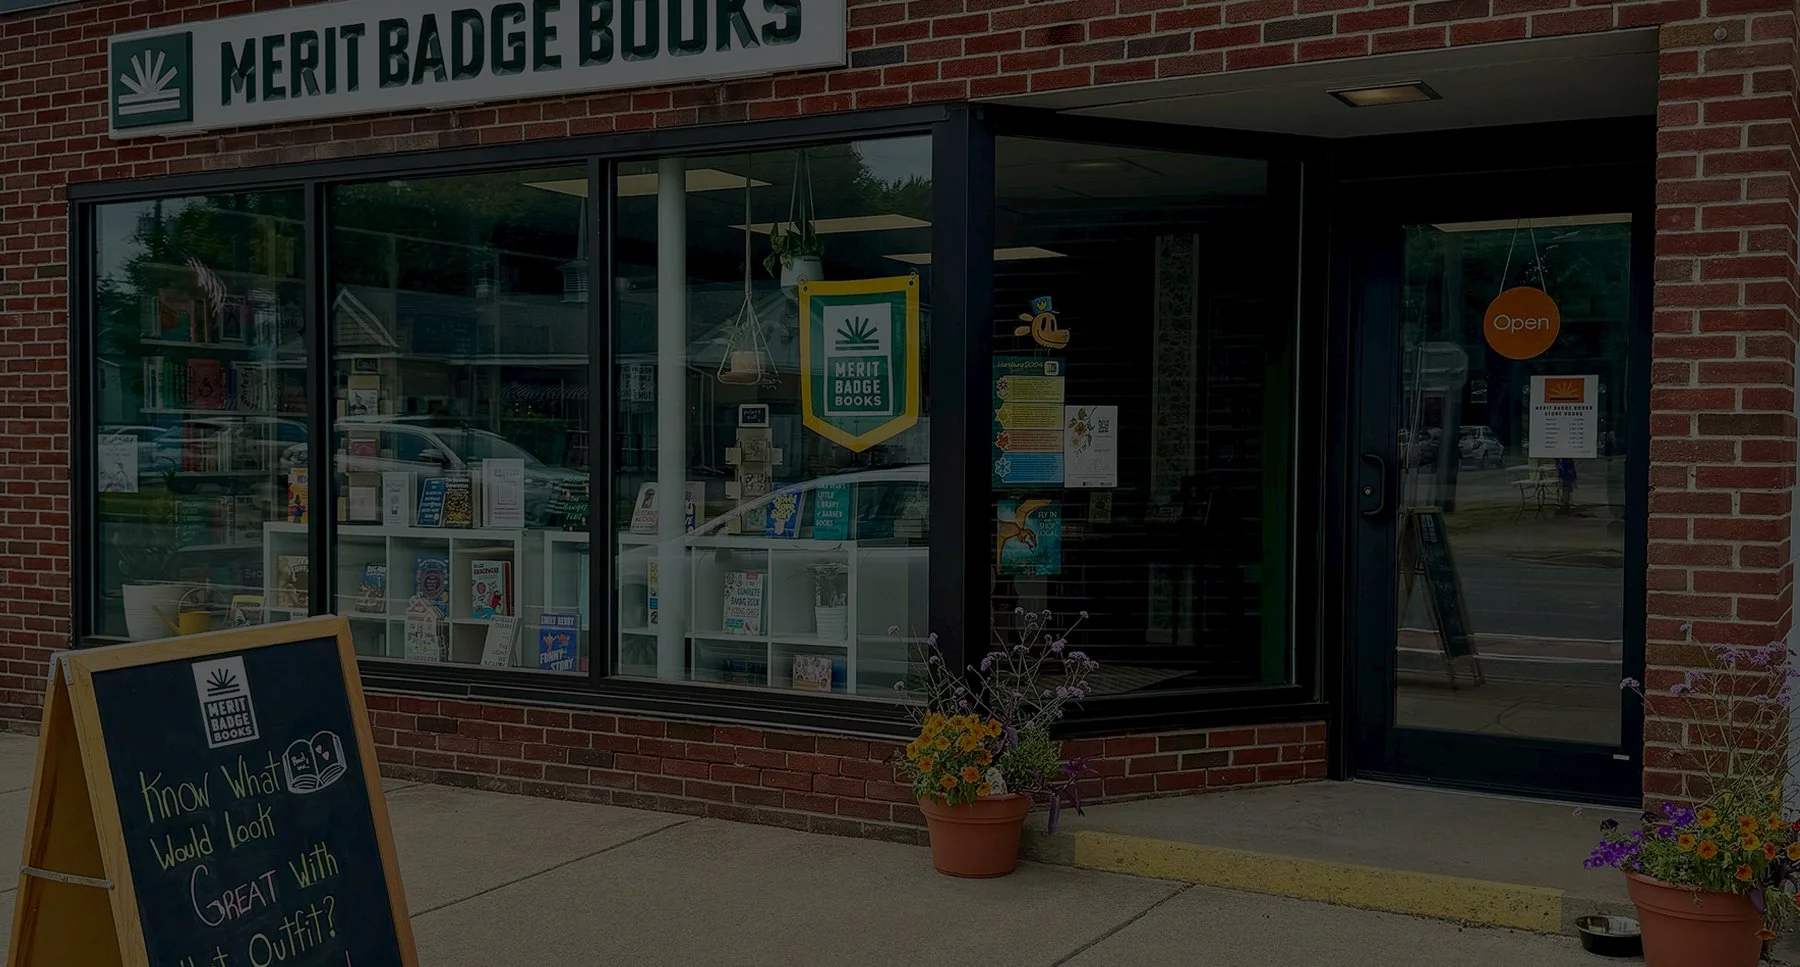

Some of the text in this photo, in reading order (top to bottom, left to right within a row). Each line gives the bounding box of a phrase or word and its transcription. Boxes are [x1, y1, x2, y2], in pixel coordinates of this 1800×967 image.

[221, 0, 801, 106] MERIT BADGE BOOKS
[1493, 314, 1550, 334] Open
[835, 361, 880, 377] MERIT
[835, 379, 881, 394] BADGE
[835, 395, 882, 407] BOOKS
[207, 697, 248, 717] MERIT
[209, 712, 251, 732] BADGE
[212, 726, 253, 742] BOOKS
[139, 750, 281, 824] Know What
[149, 823, 214, 870] Would
[190, 841, 340, 927] GREAT With
[249, 895, 336, 967] Outfit?
